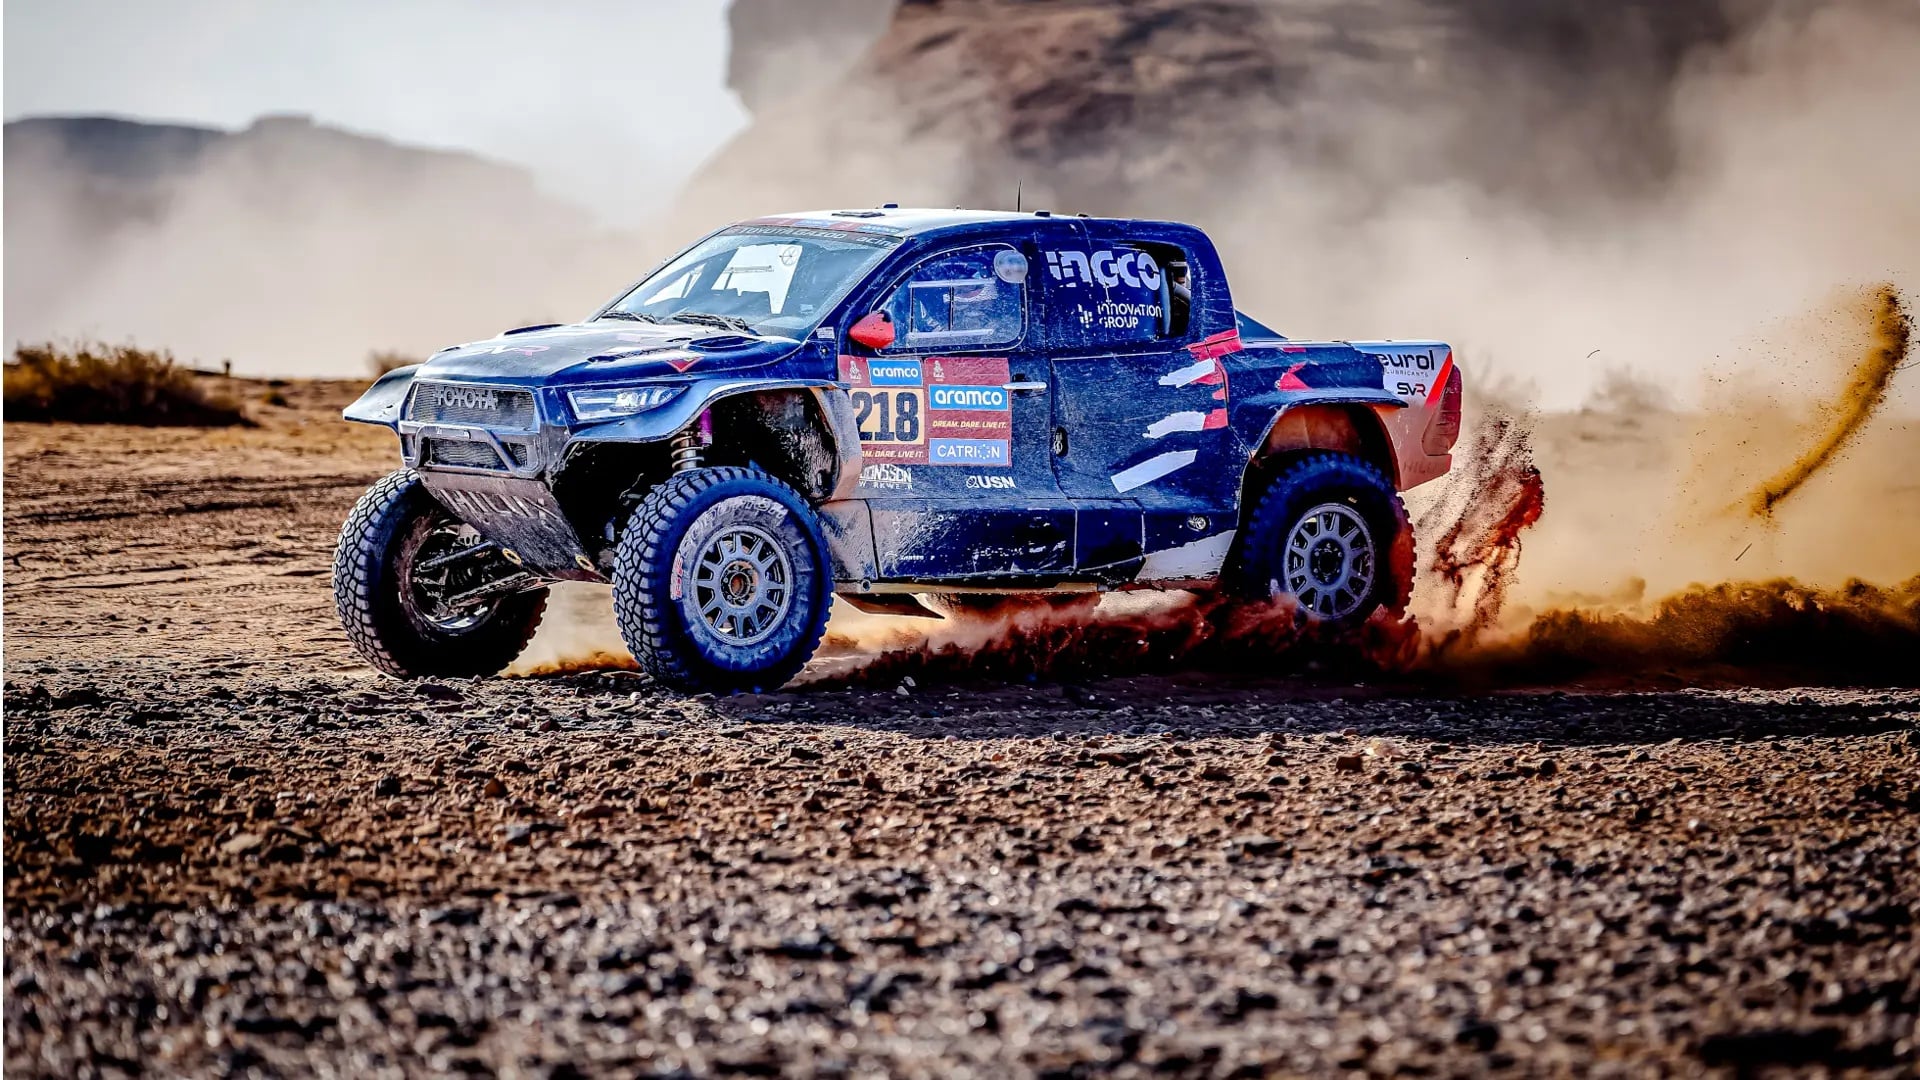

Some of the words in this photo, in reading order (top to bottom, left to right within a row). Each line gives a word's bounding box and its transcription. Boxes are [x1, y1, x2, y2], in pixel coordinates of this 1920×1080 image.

[1376, 350, 1435, 371] eurol
[872, 367, 919, 378] aramco
[1397, 382, 1426, 397] SVR
[432, 385, 499, 411] TOYOTA
[934, 389, 1003, 406] aramco
[852, 391, 920, 442] 218
[932, 420, 960, 429] DREAM.
[982, 421, 998, 429] LIVE
[897, 450, 915, 458] LIVE
[937, 444, 1001, 460] CATRION
[979, 476, 1016, 489] USN
